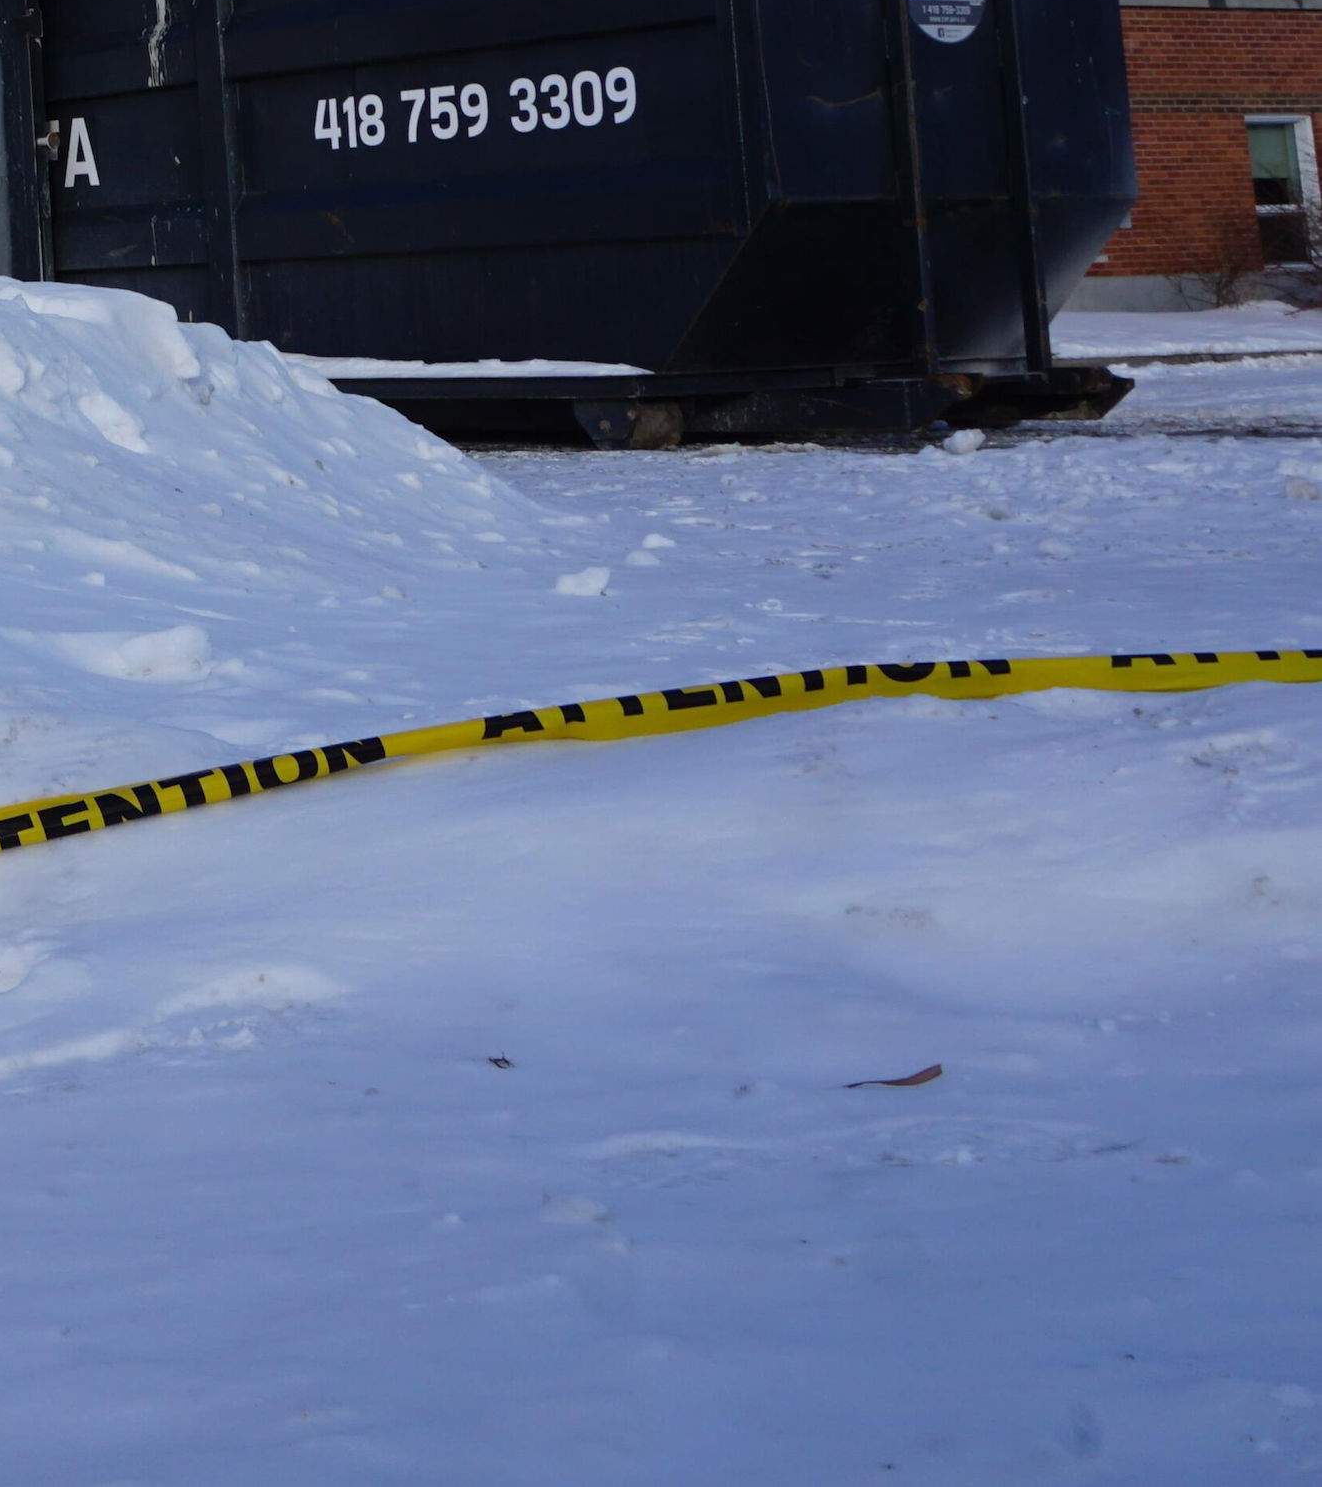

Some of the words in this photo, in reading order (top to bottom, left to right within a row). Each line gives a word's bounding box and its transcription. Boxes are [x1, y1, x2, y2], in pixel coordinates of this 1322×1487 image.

[313, 93, 386, 150] 418
[400, 82, 489, 143] 759
[509, 65, 637, 134] 3309
